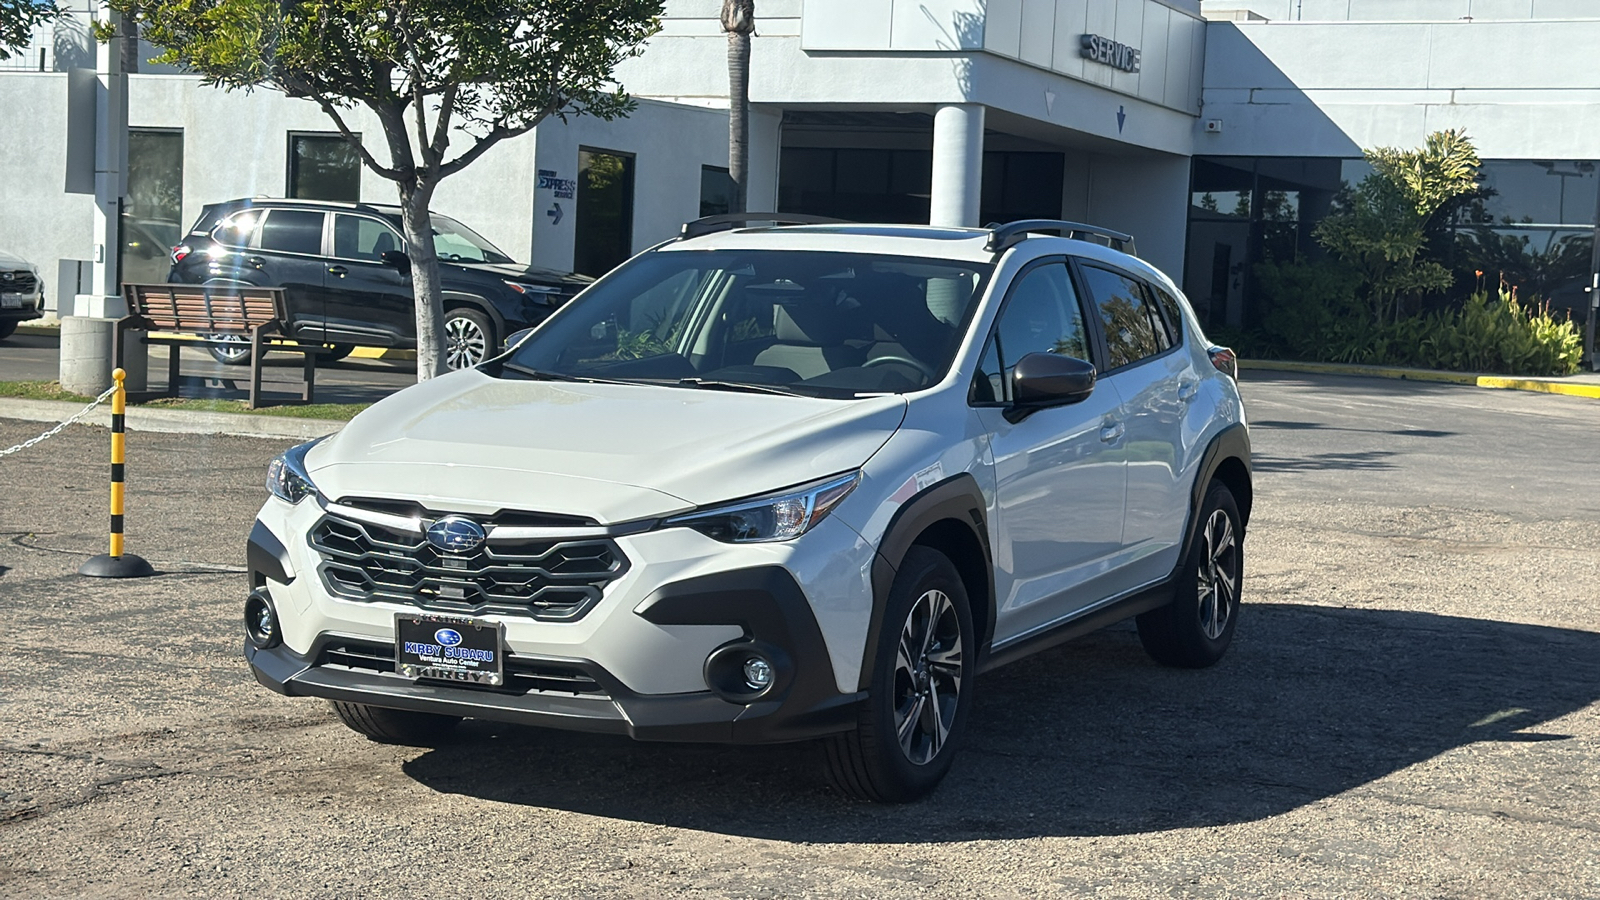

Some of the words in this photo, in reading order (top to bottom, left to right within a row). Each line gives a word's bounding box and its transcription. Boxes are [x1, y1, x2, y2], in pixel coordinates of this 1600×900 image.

[1085, 34, 1141, 73] SERVICE
[405, 642, 442, 656] KIRBY
[445, 646, 494, 662] SUBARU
[419, 655, 442, 663] Ventura
[443, 657, 458, 665] Auto
[459, 659, 480, 667] Center
[416, 667, 483, 681] KIRBY
